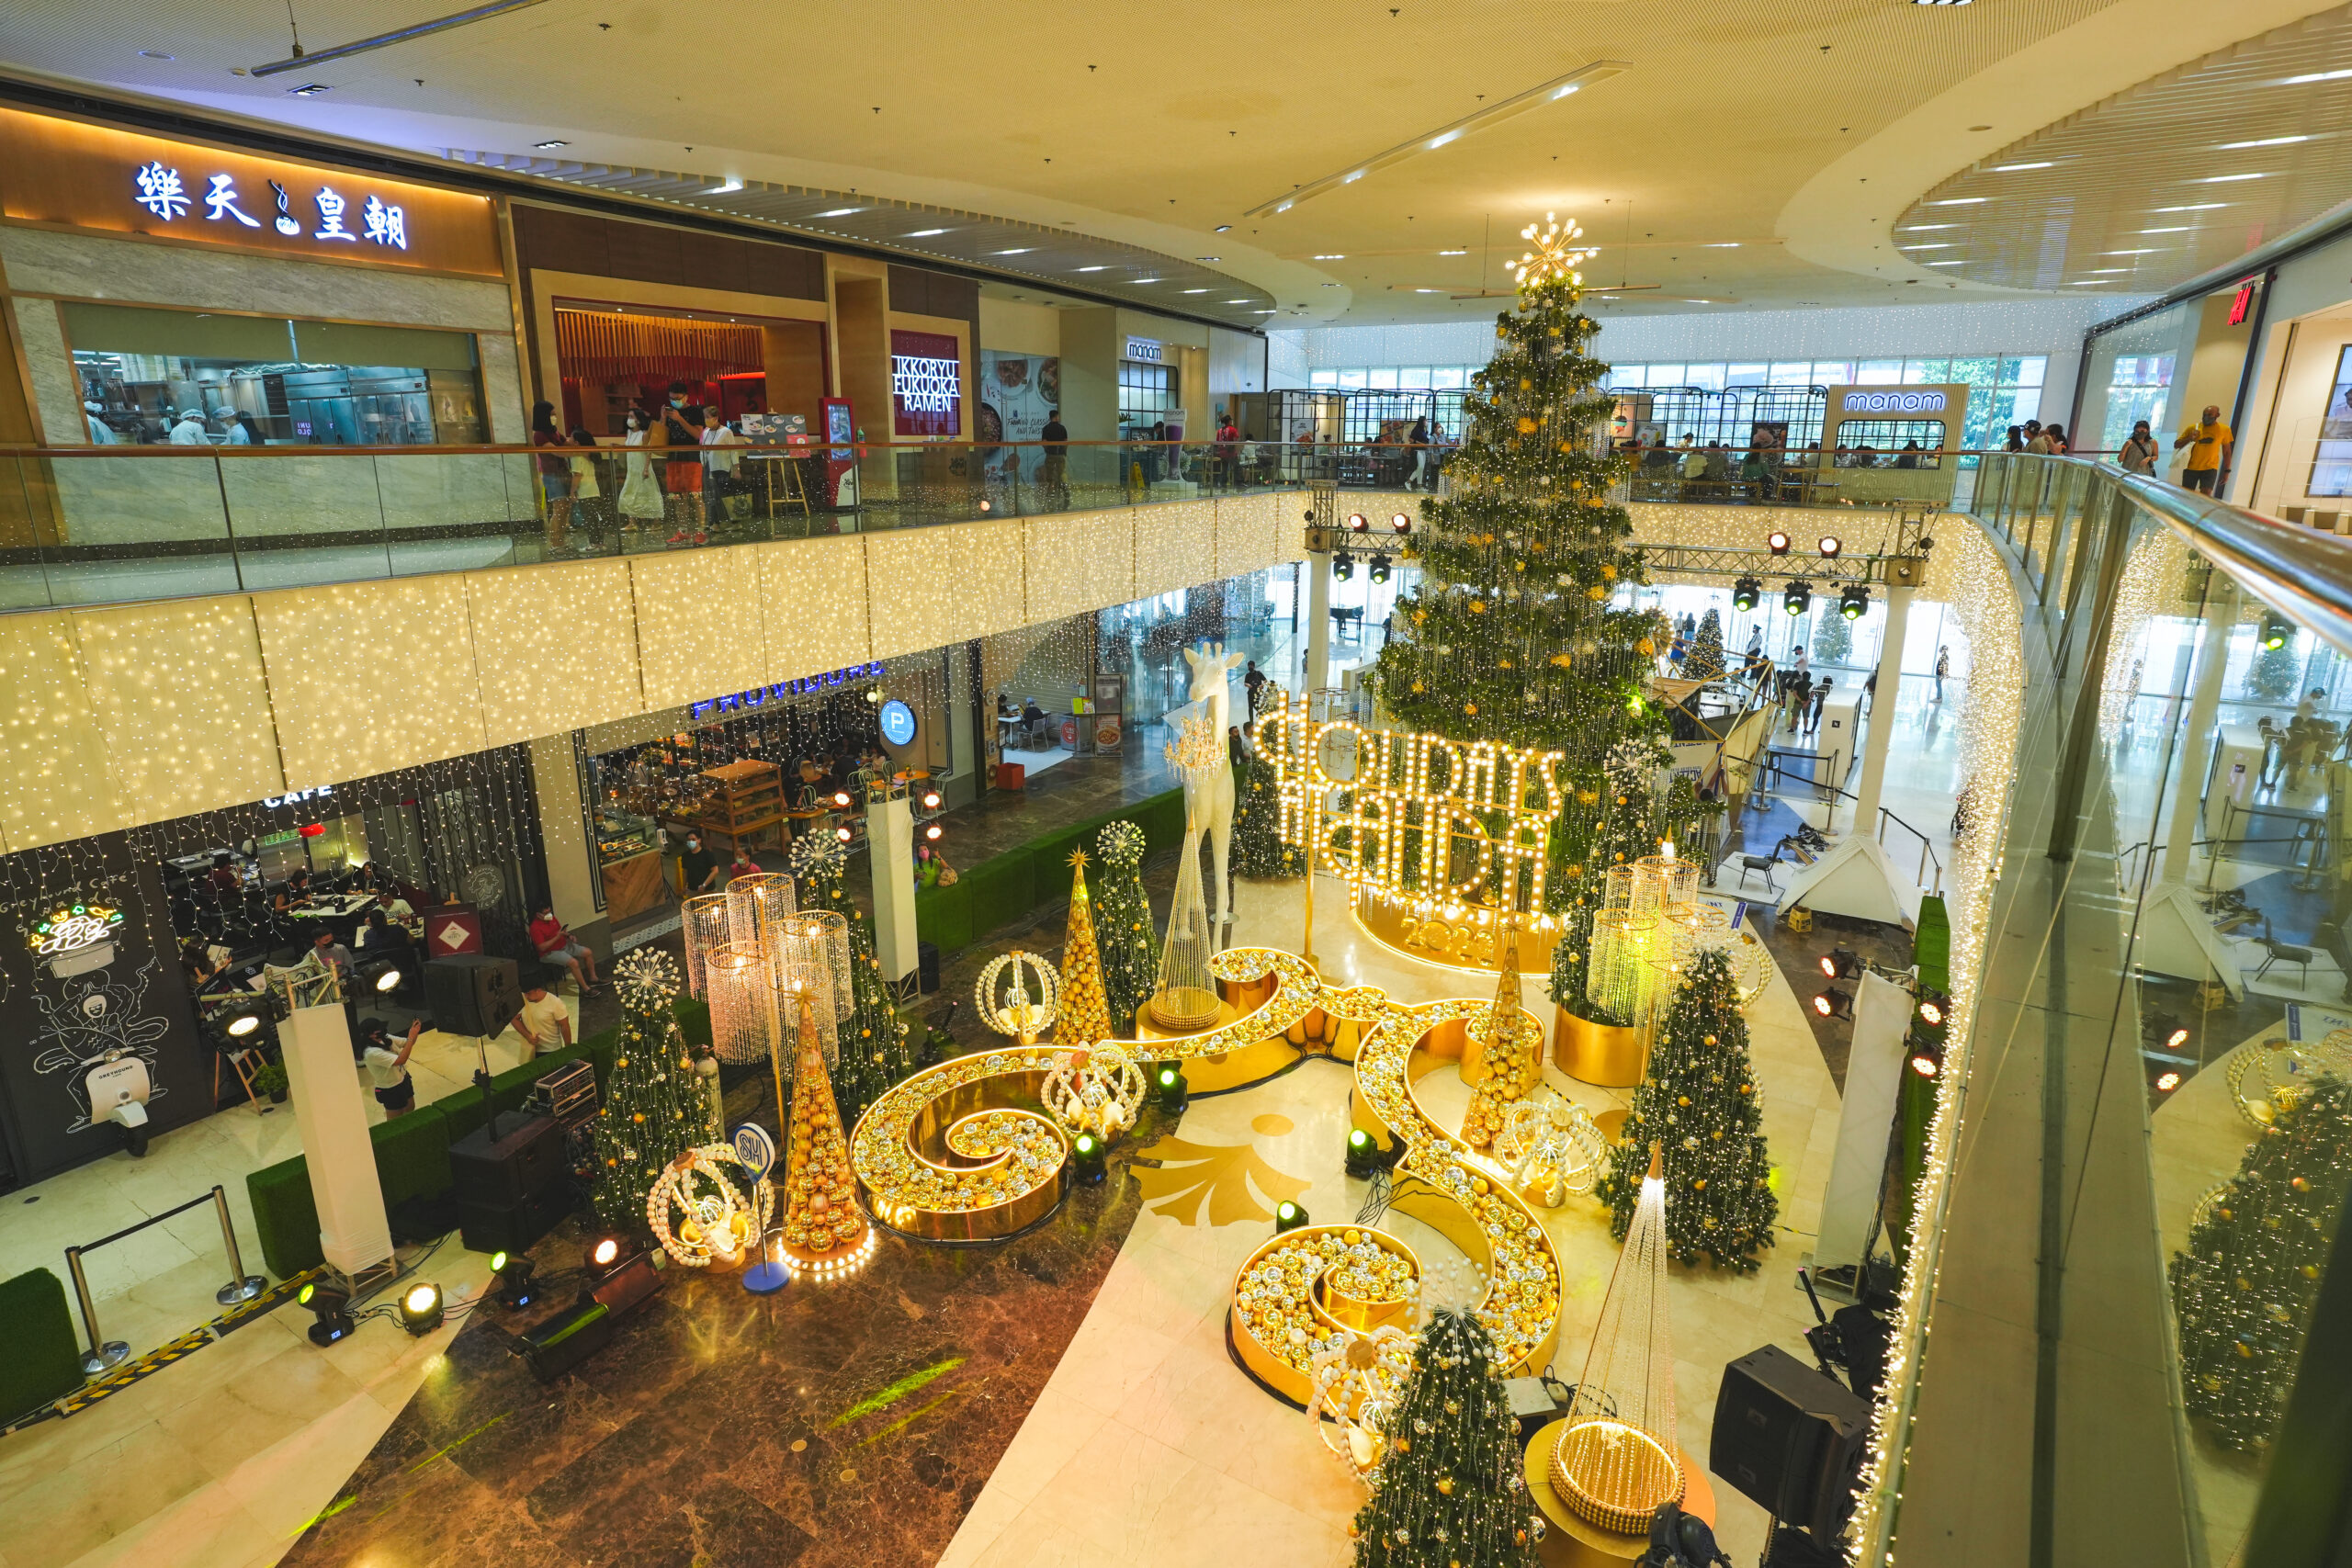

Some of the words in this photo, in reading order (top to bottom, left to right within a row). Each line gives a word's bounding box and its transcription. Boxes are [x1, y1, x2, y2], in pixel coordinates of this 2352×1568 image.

[1128, 344, 1161, 360] manam
[897, 356, 956, 378] IKKORYU
[894, 376, 958, 395] FUKUOKA
[904, 394, 951, 412] RAMEN
[1846, 394, 1944, 410] manam
[891, 712, 905, 729] P
[1252, 690, 1566, 824] HOLIDAYS
[1321, 792, 1553, 932] AURA
[89, 872, 128, 888] Café
[1400, 914, 1495, 967] 2022
[98, 1065, 133, 1079] GREYHOUND
